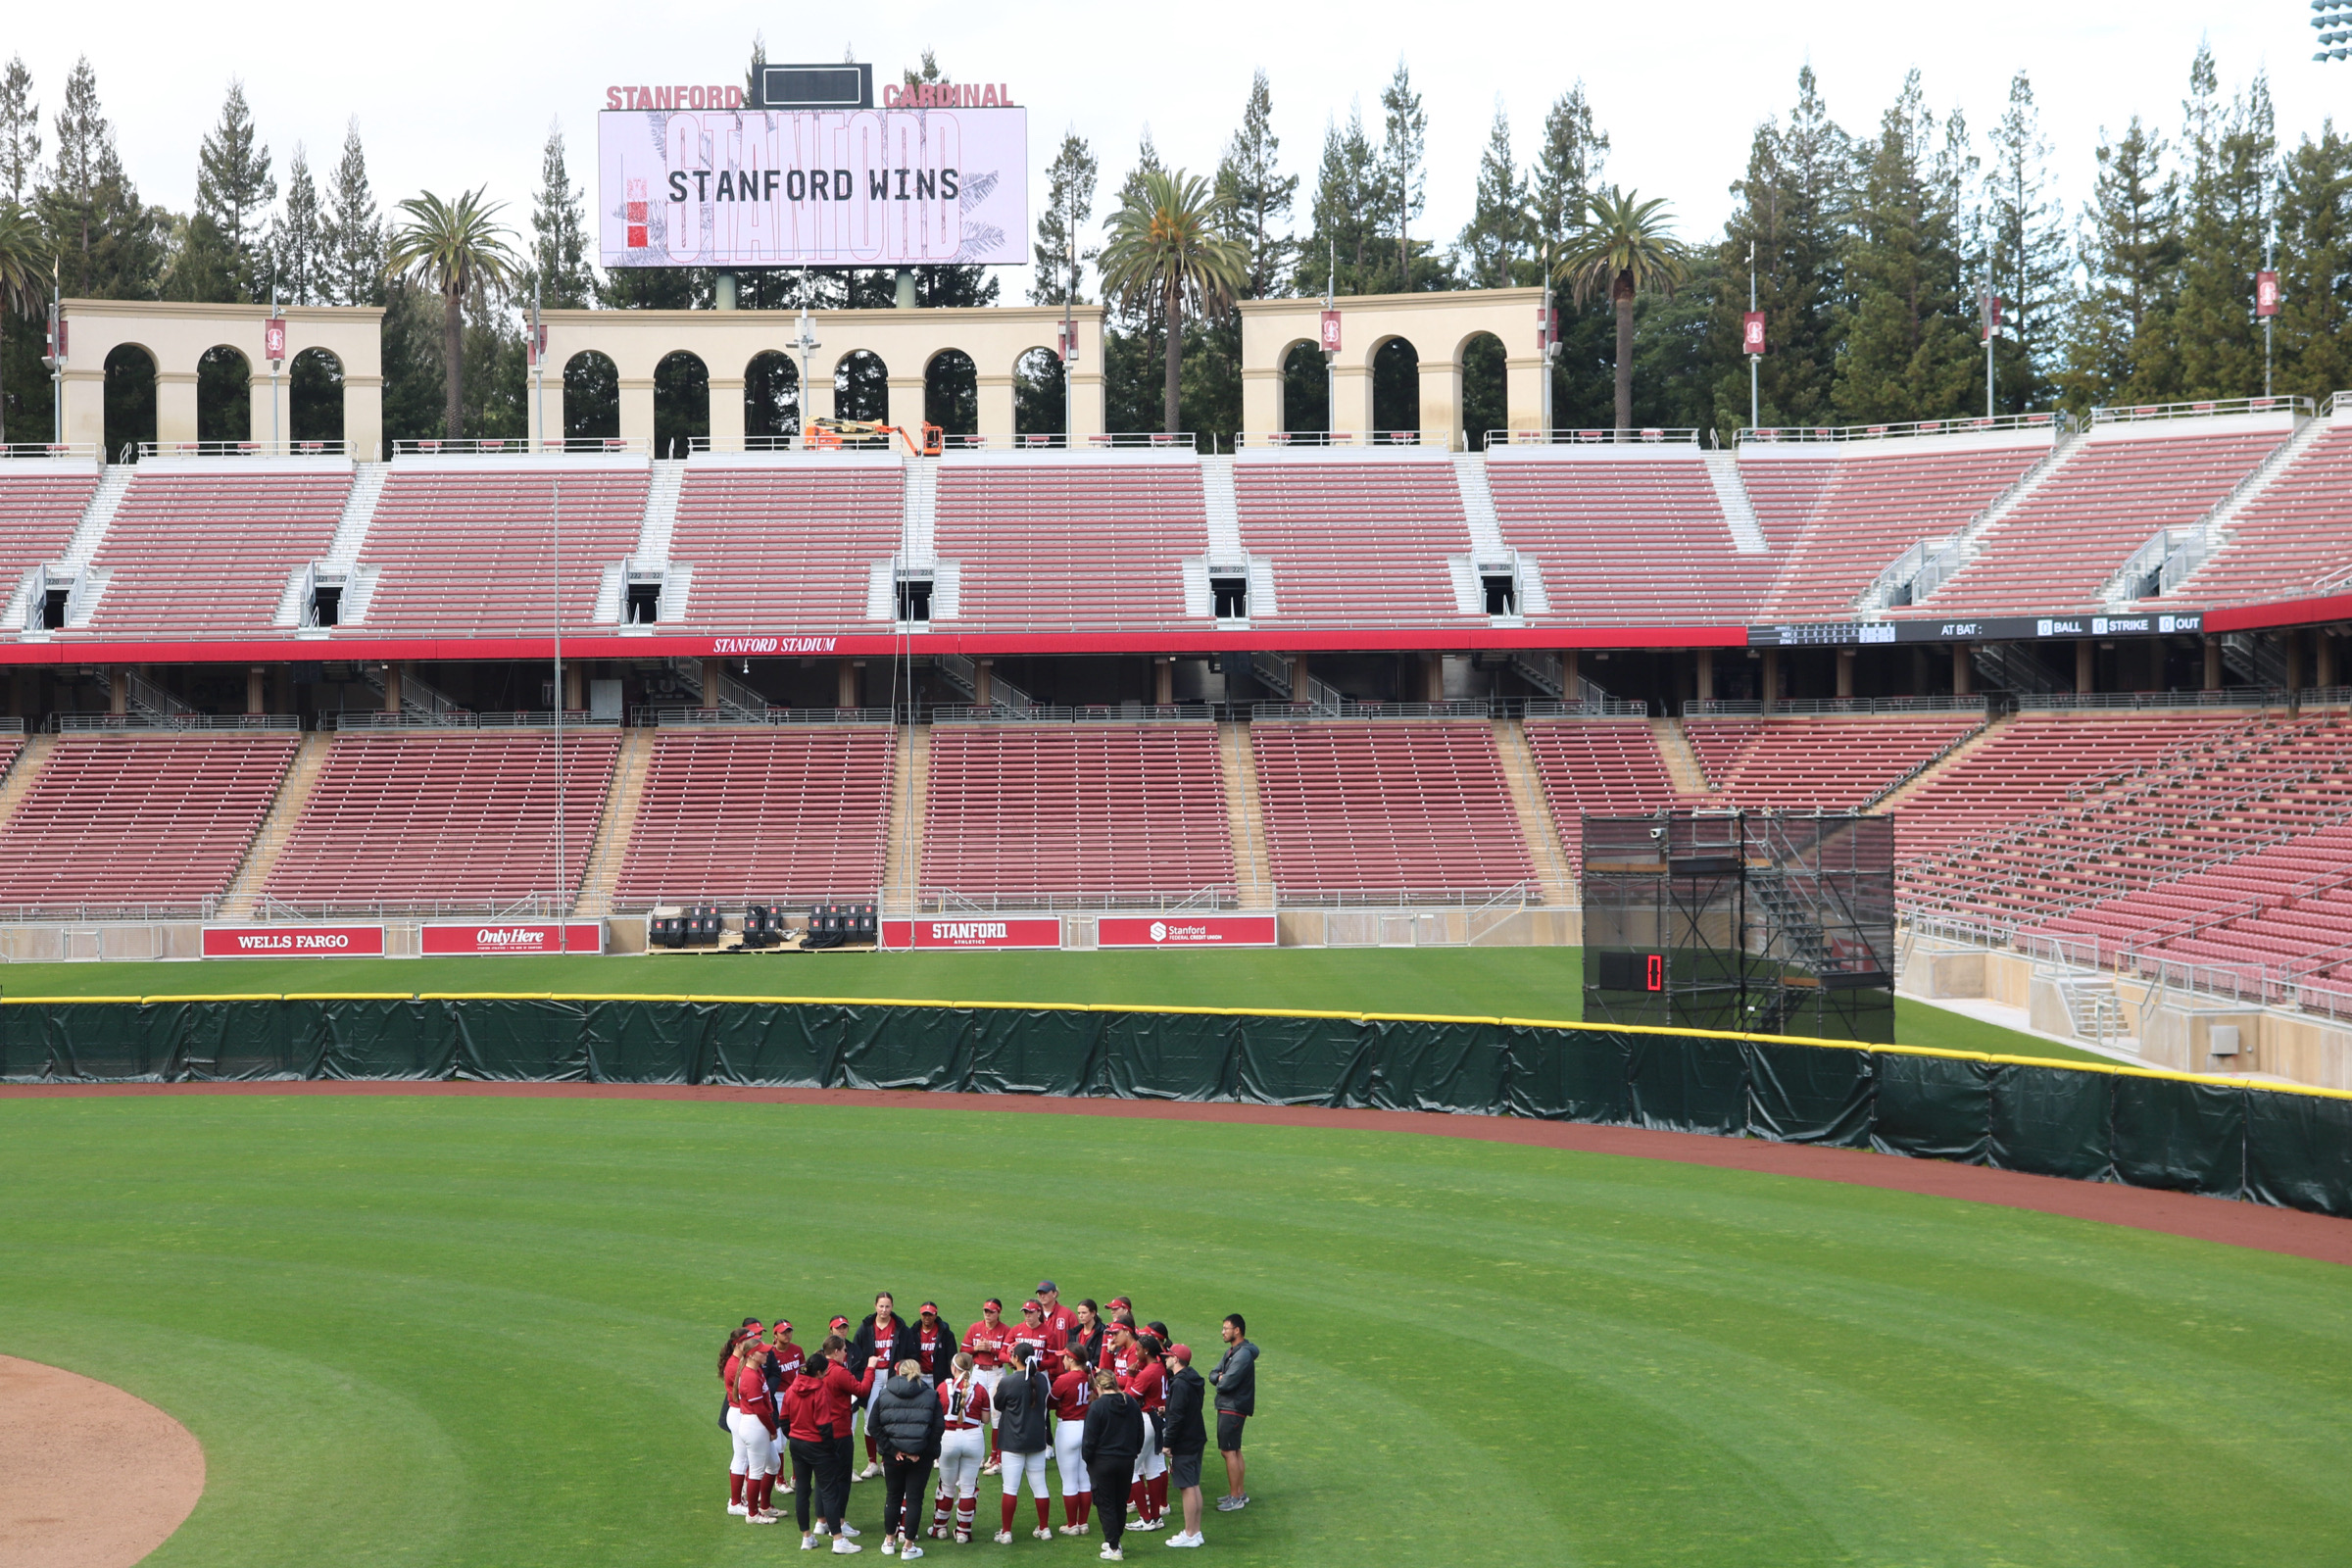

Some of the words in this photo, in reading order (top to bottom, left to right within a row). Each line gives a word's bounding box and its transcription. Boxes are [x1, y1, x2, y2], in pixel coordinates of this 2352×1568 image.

[606, 85, 743, 111] STANFORD
[882, 83, 1014, 108] CARDINAL
[668, 169, 854, 203] STANFORD
[868, 168, 960, 201] WINS
[1941, 624, 1955, 636] AT
[1956, 623, 1977, 635] BAT
[2053, 621, 2082, 633] BALL
[2109, 619, 2149, 632] STRIKE
[2176, 617, 2200, 630] OUT
[713, 638, 778, 653] STANFORD
[780, 637, 837, 652] STADIUM
[476, 929, 512, 946] Only
[510, 928, 545, 943] Here
[1168, 925, 1206, 935] Stanford
[238, 935, 292, 949] WELLS
[296, 934, 349, 949] FARGO
[1647, 955, 1662, 992] 0
[883, 1348, 891, 1361] 4
